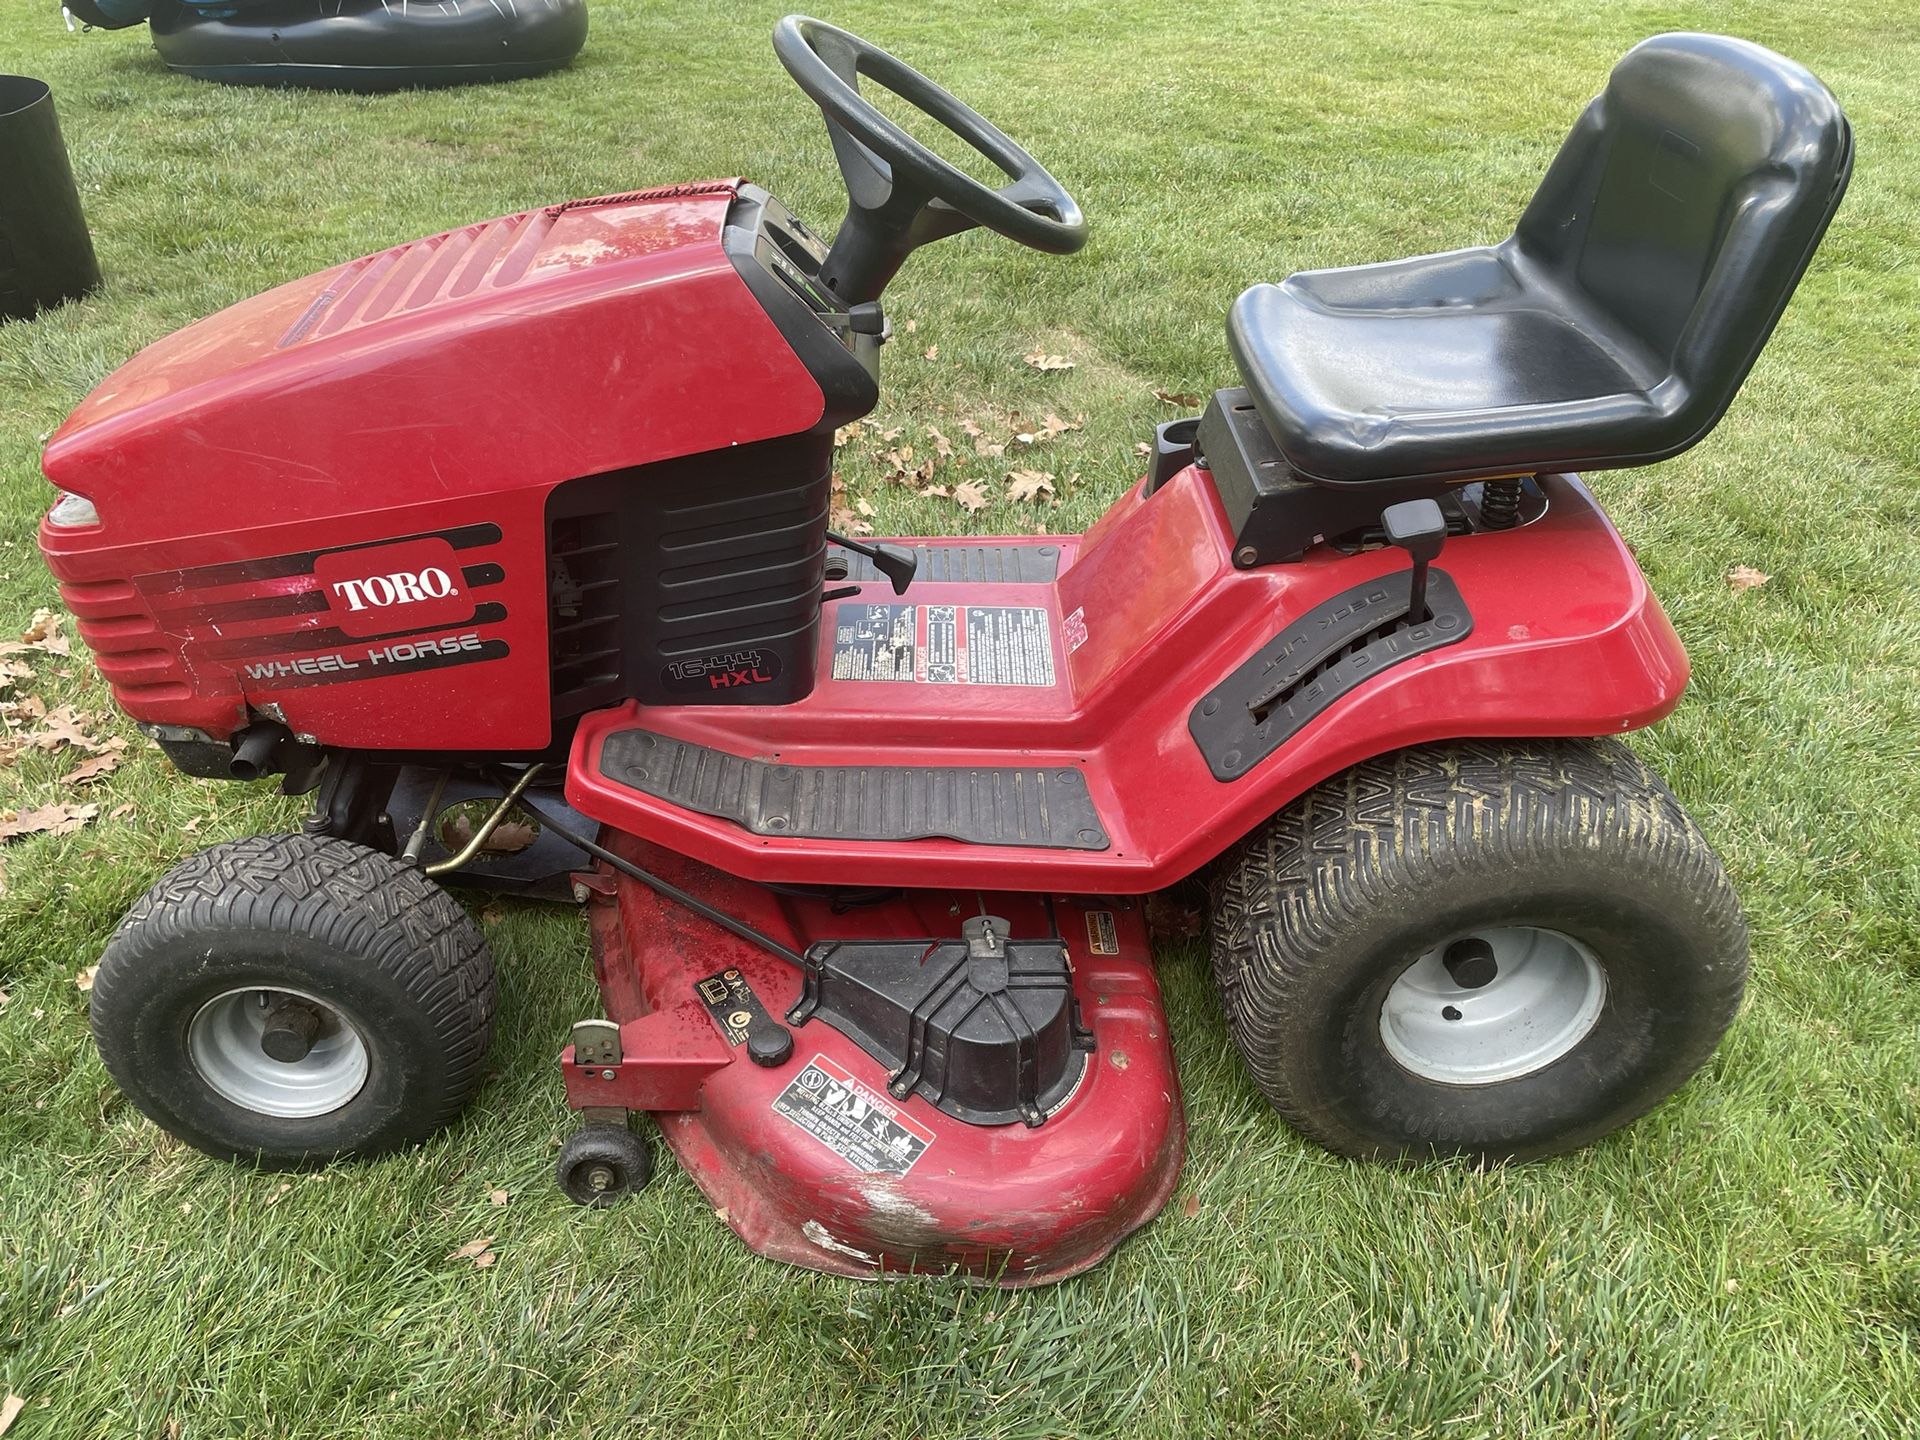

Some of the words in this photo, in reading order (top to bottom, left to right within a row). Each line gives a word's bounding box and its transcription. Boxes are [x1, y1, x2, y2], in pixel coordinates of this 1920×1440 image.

[244, 656, 359, 680] WHEEL
[367, 633, 484, 666] HORSE
[669, 650, 761, 680] 16-44
[709, 668, 772, 689] HXL
[852, 1084, 899, 1119] DANGER
